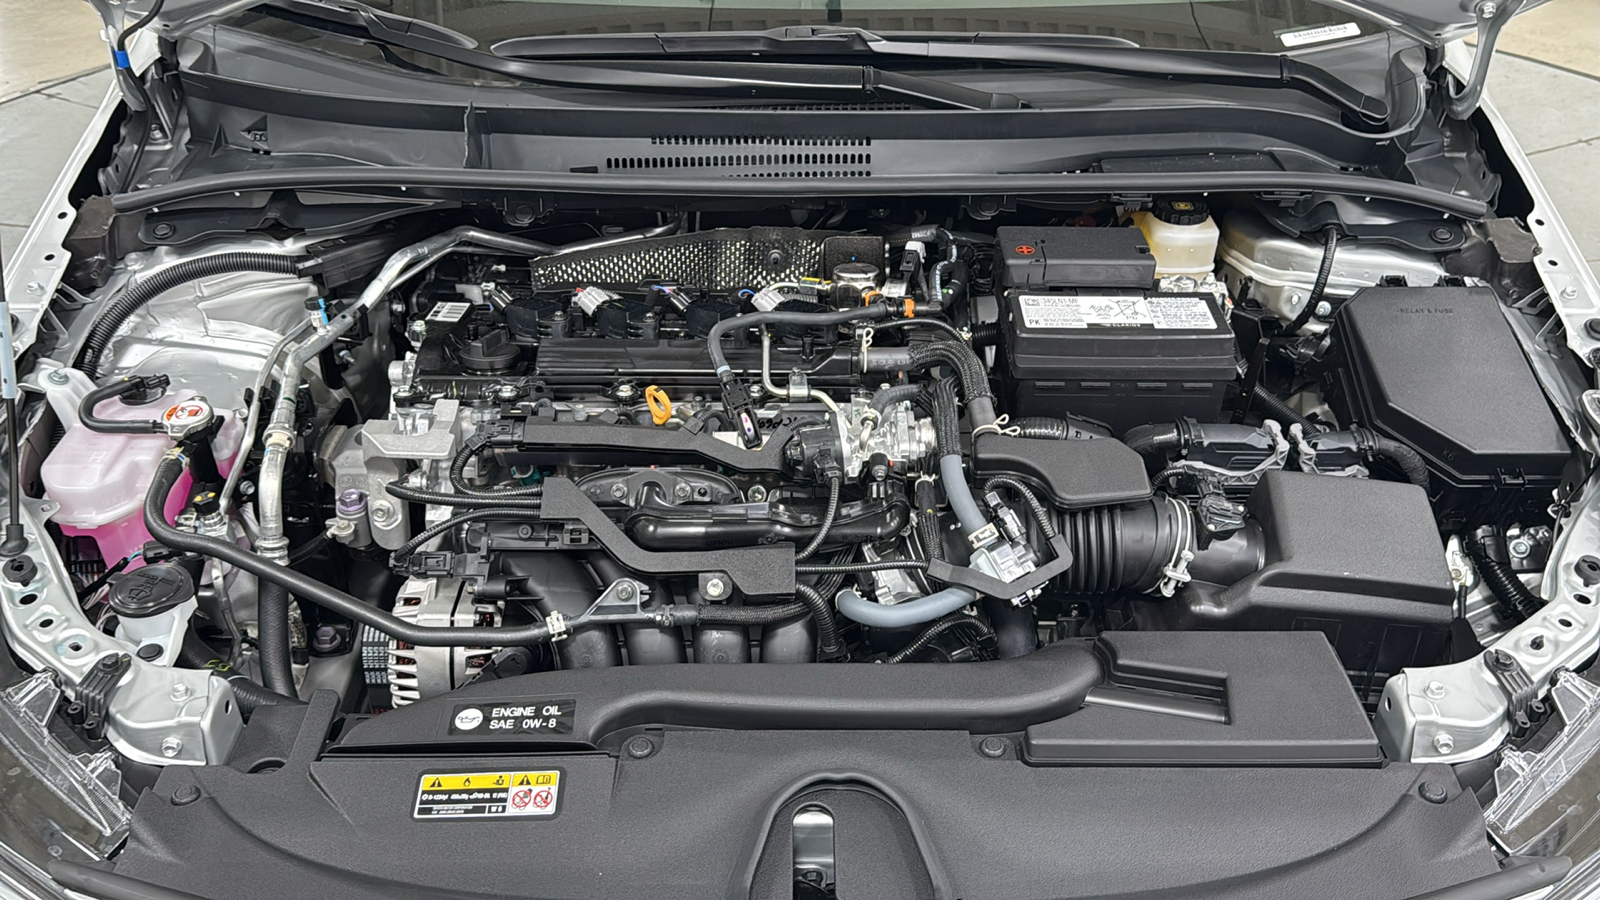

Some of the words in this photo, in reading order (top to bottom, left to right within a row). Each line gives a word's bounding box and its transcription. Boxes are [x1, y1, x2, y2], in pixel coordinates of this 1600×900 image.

[492, 707, 535, 717] ENGINE
[542, 706, 562, 716] OIL
[489, 719, 515, 729] SAE
[522, 718, 556, 728] 0W-8
